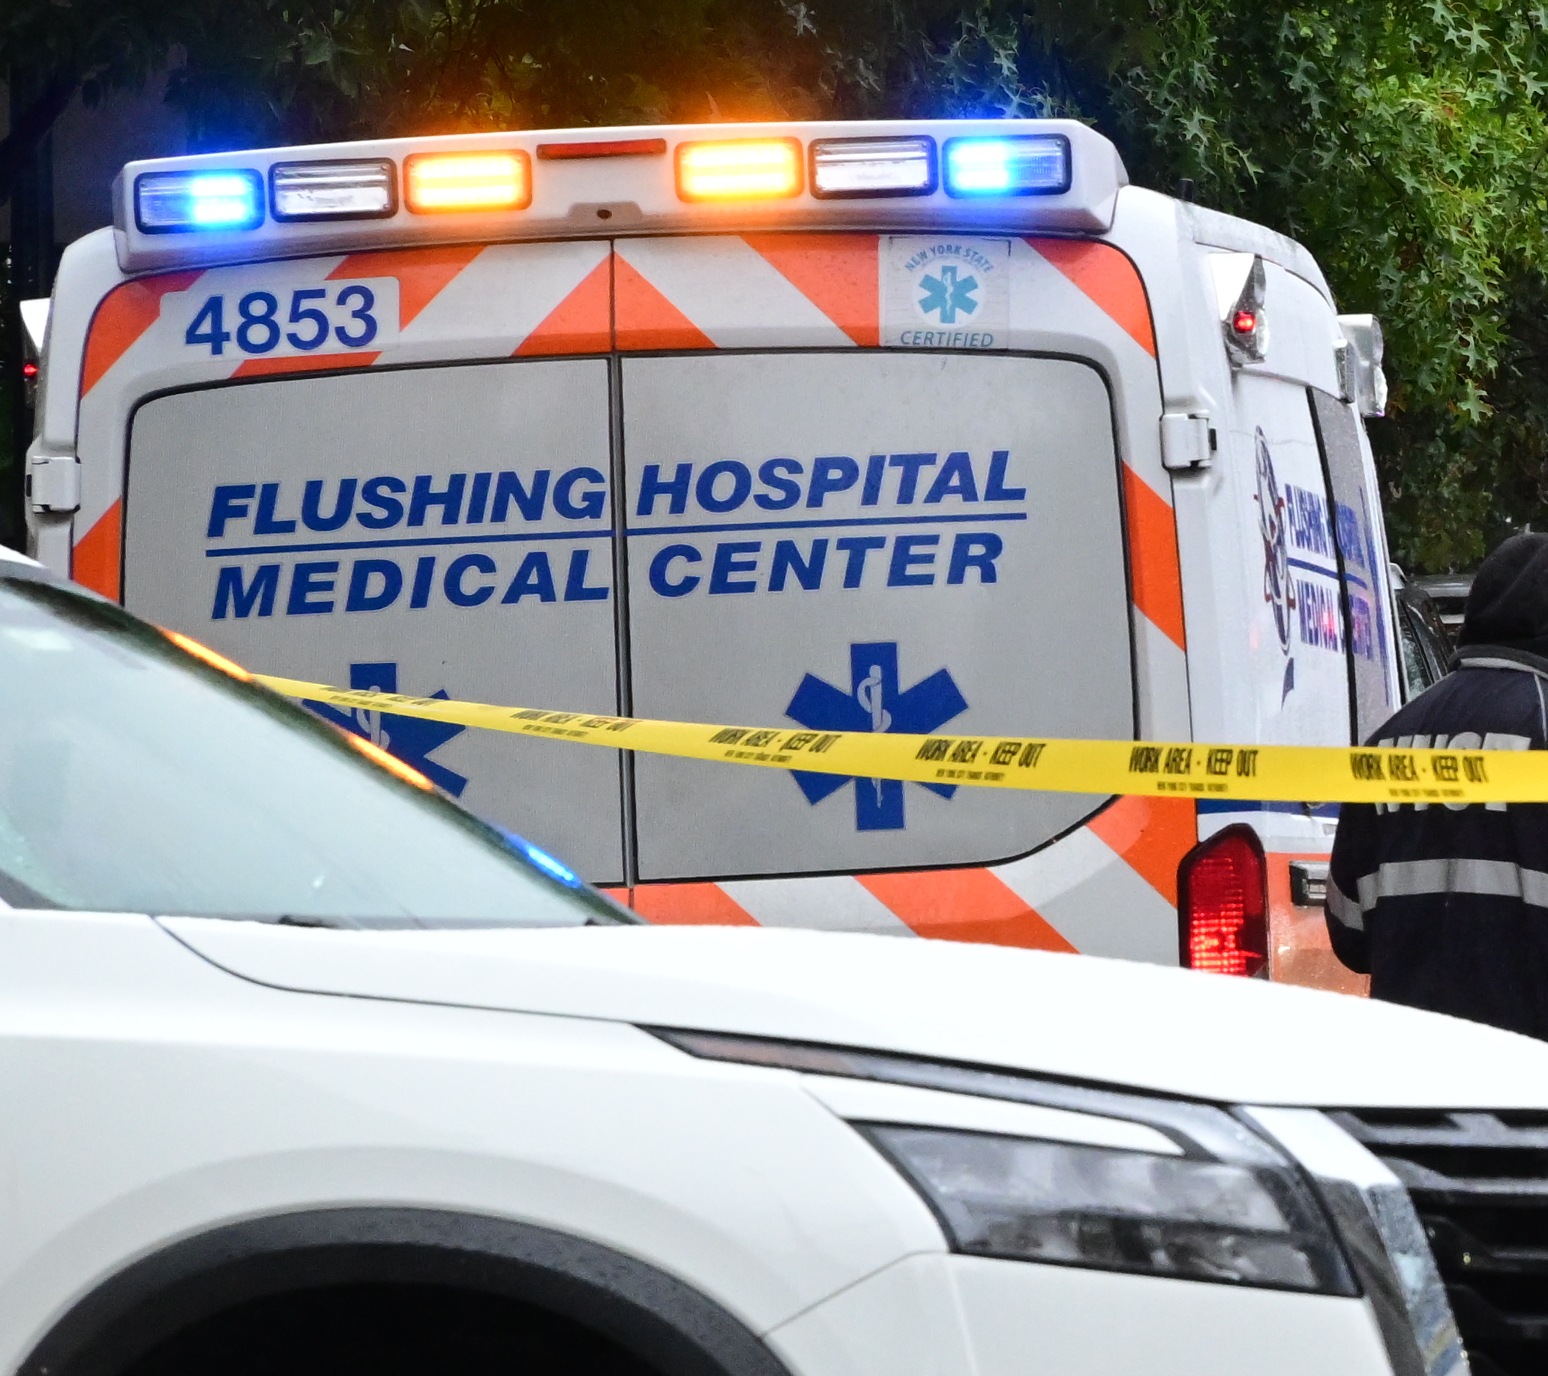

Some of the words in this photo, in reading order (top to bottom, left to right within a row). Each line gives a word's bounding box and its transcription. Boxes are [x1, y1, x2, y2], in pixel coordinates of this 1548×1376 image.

[904, 250, 928, 272] NEW
[930, 244, 962, 255] YORK
[963, 248, 994, 273] STATE
[185, 284, 379, 356] 4853
[900, 330, 994, 348] CERTIFIED
[207, 466, 608, 538] FLUSHING
[636, 450, 1027, 517] HOSPITAL
[211, 549, 610, 620] MEDICAL
[649, 532, 1004, 598] CENTER
[915, 738, 954, 761] WORK
[949, 740, 983, 763] AREA
[989, 741, 1021, 765] KEEP
[1019, 743, 1047, 768] OUT
[1129, 746, 1163, 773] WORK
[1163, 748, 1193, 775] AREA
[1206, 748, 1234, 776] KEEP
[1237, 749, 1259, 778] OUT
[1350, 753, 1382, 782] WORK
[1388, 754, 1419, 783] AREA
[1430, 755, 1460, 784] KEEP
[1462, 756, 1489, 784] OUT
